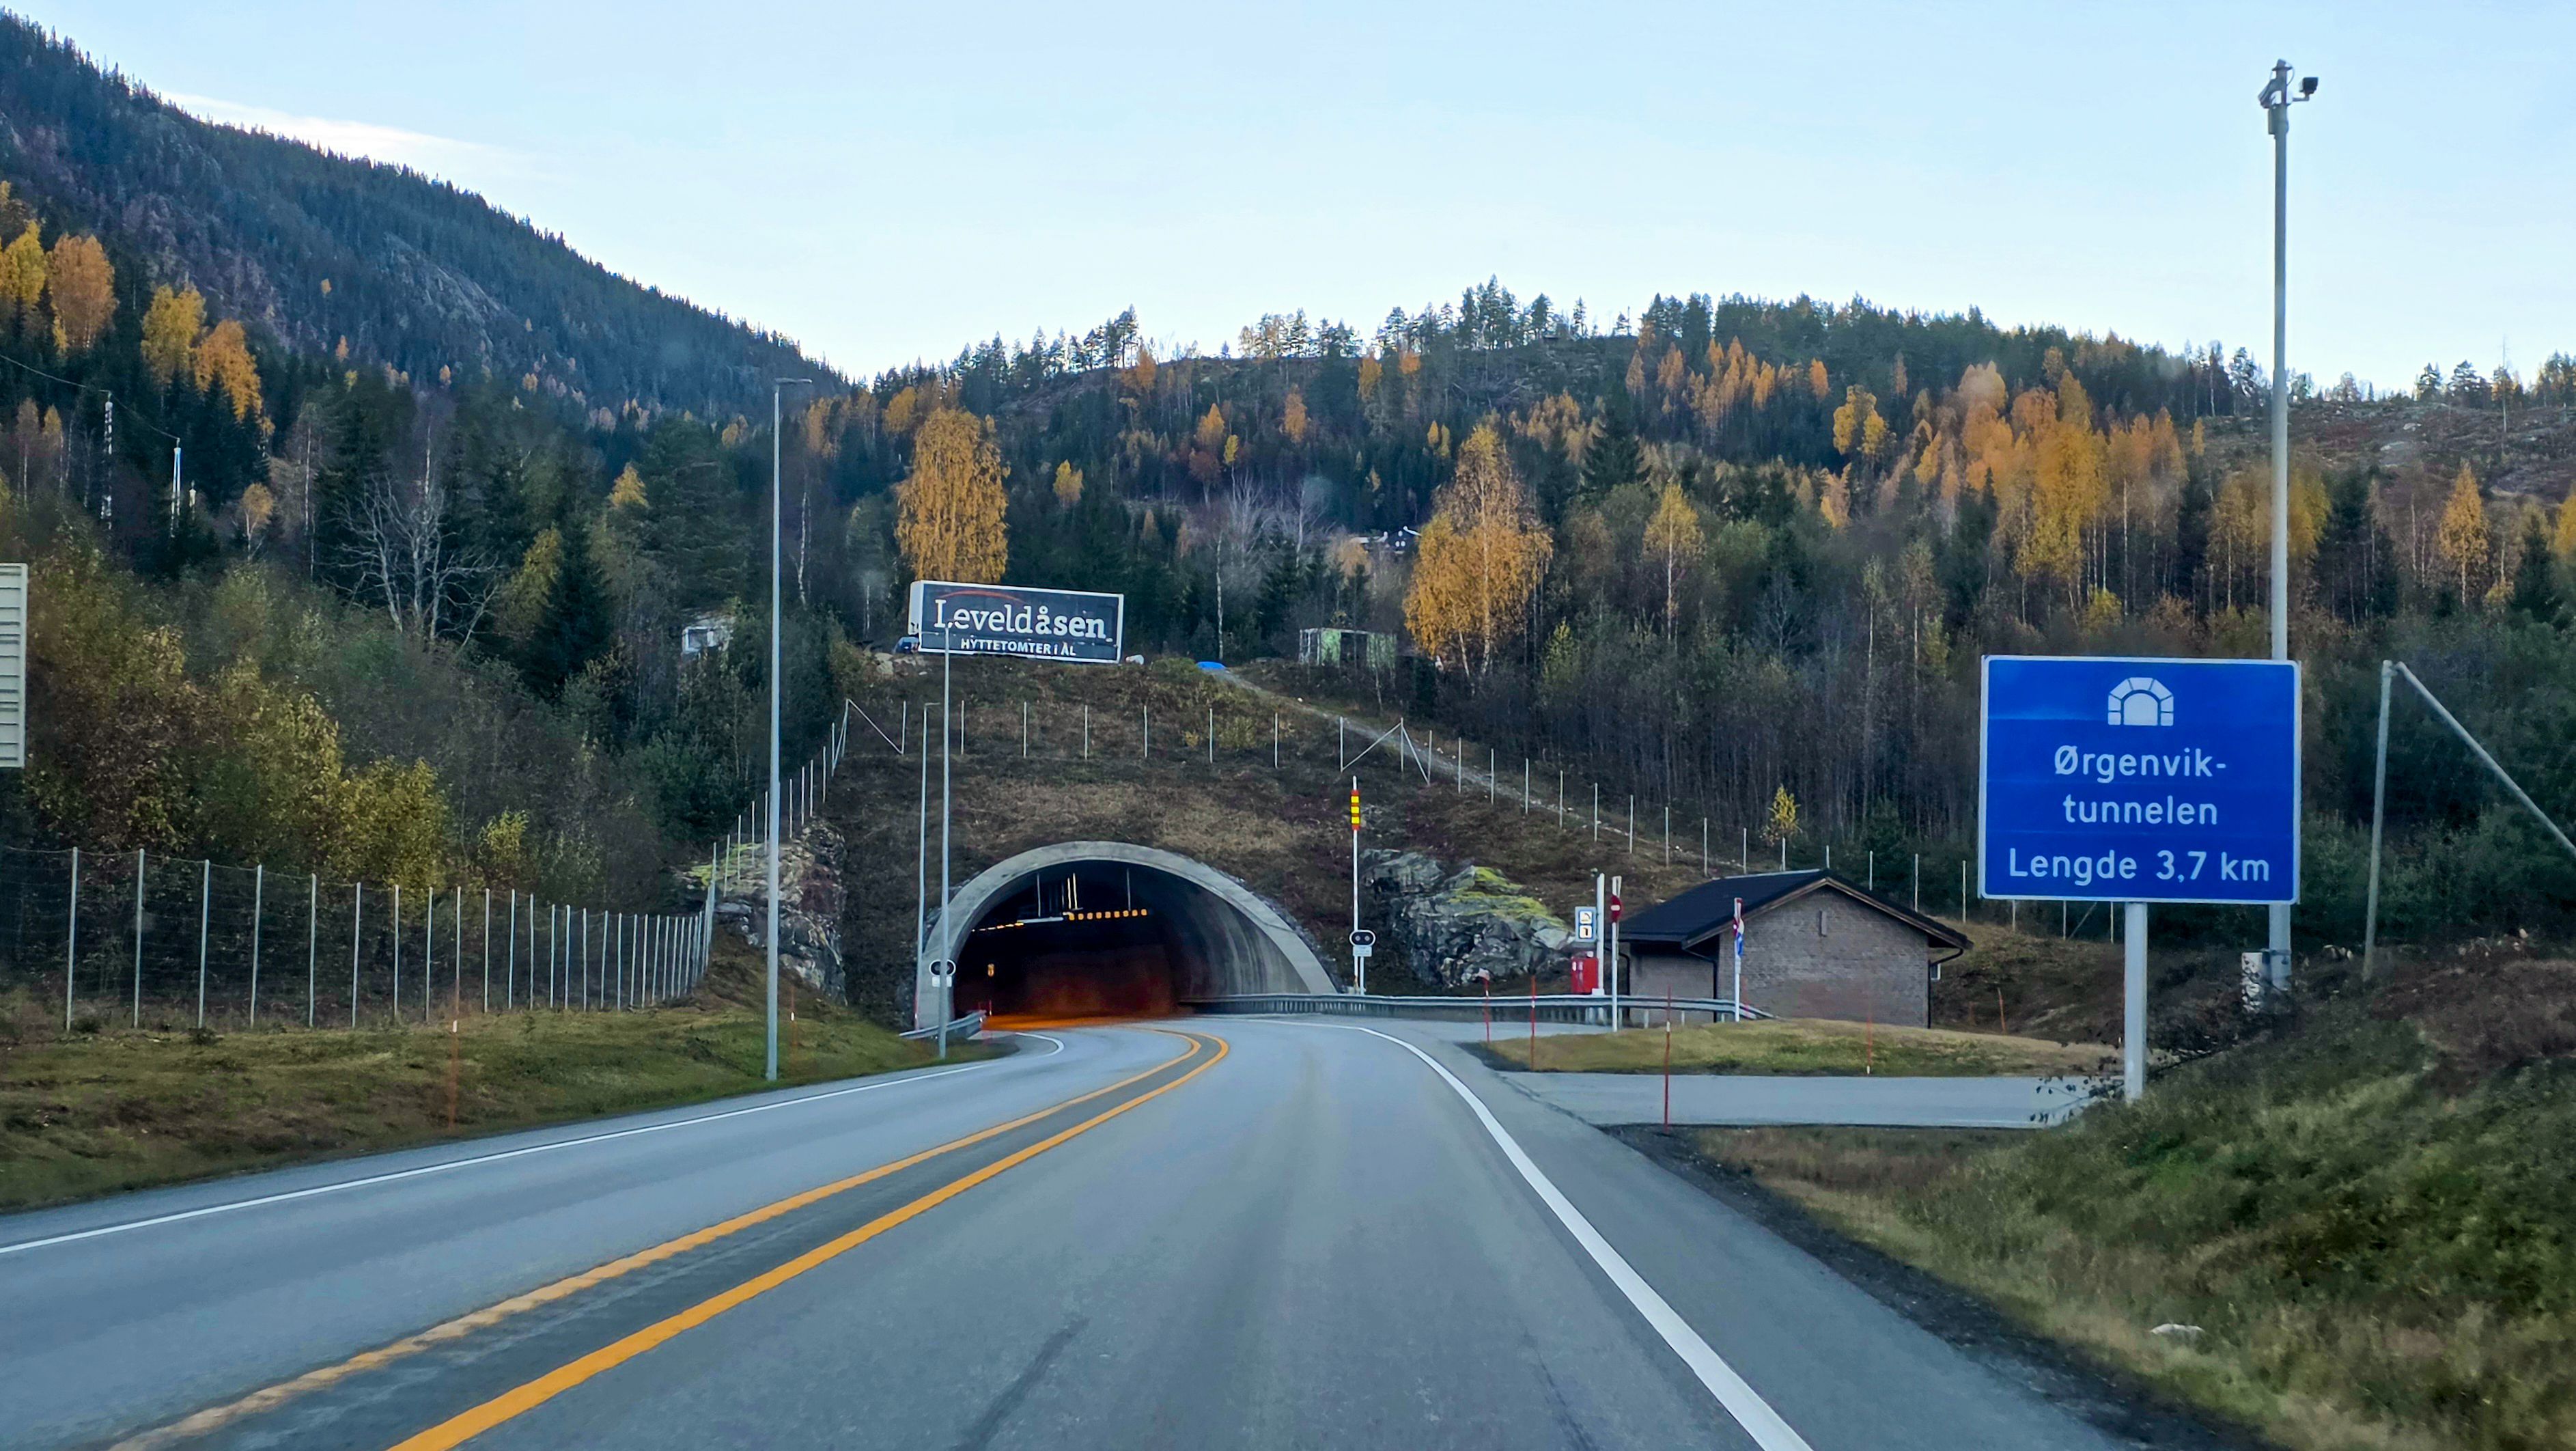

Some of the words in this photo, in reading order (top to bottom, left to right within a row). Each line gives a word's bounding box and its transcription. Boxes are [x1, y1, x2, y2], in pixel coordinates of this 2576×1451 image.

[934, 599, 1106, 639] Leveldåsen
[960, 638, 1052, 654] HYTTETOMTER
[2054, 745, 2226, 784] Ørgenvik-
[2063, 794, 2217, 825] tunnelen
[2010, 848, 2137, 886] Lengde
[2156, 850, 2207, 883] 3,7
[2221, 851, 2269, 882] km
